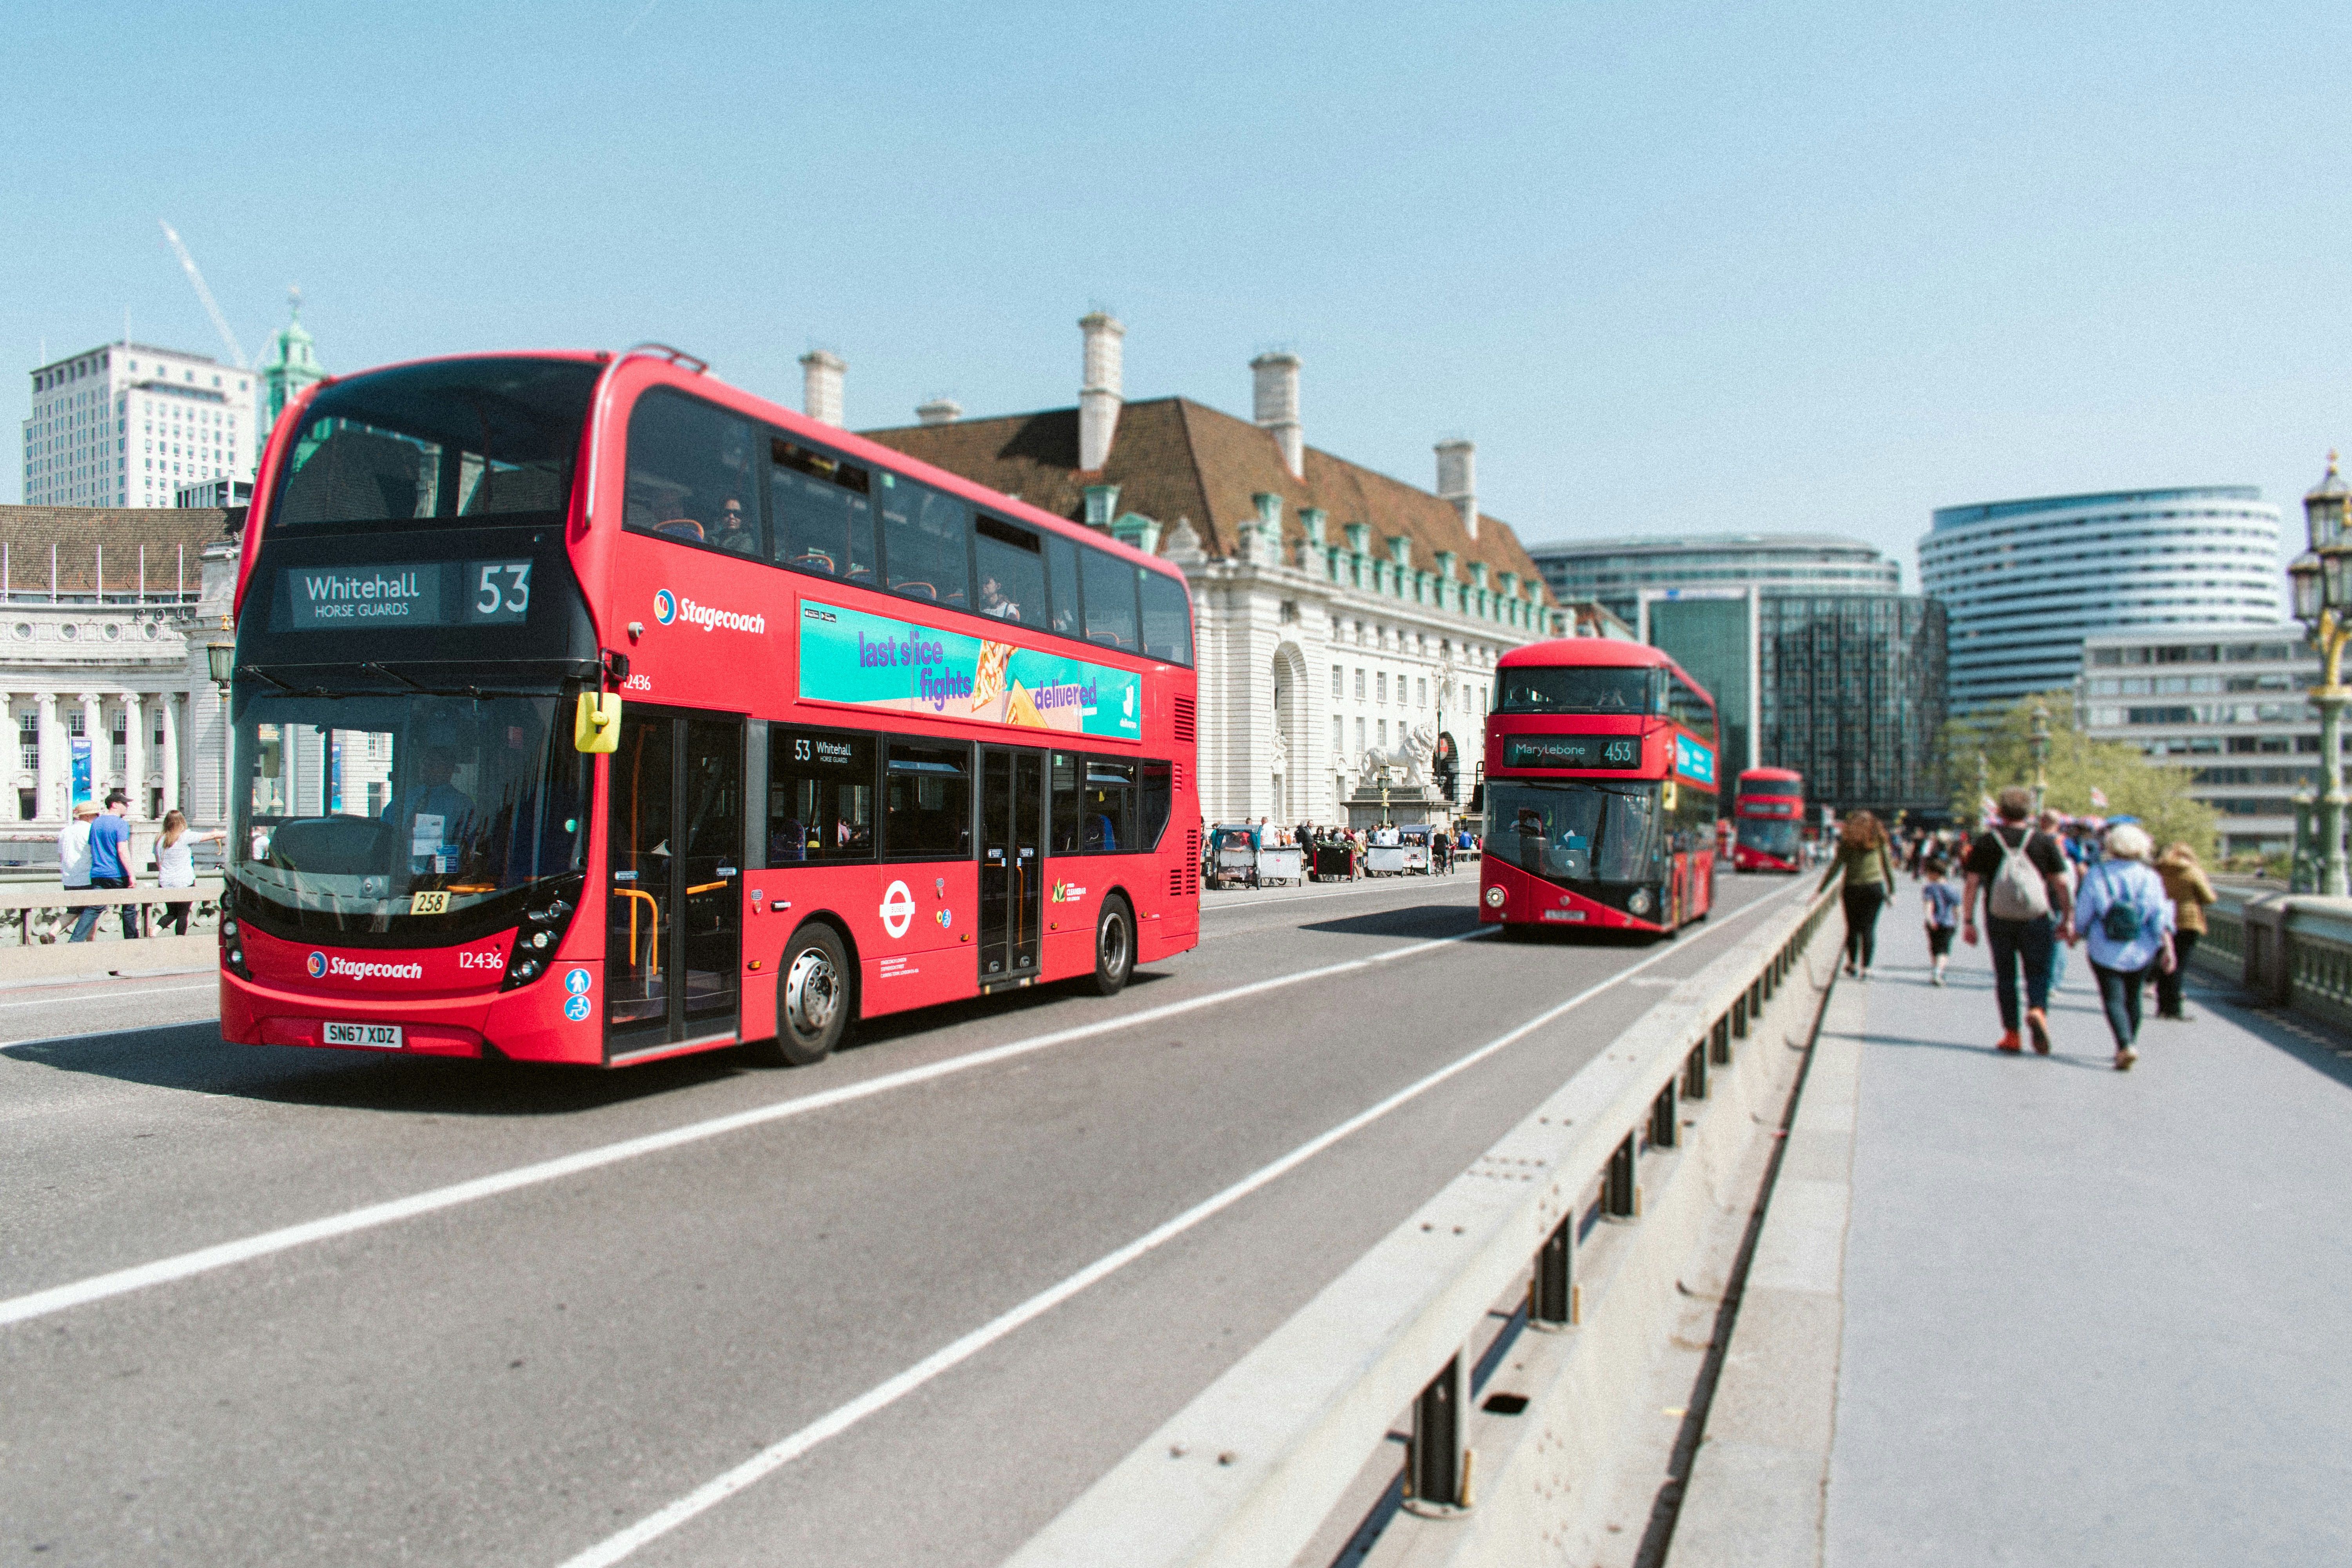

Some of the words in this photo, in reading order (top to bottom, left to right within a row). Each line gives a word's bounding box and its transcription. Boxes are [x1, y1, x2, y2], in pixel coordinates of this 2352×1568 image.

[306, 572, 421, 600] Whitehall
[477, 564, 532, 614] 53
[315, 604, 354, 618] HORSE
[358, 602, 409, 616] GUARDS
[679, 598, 765, 634] Stagecoach
[858, 631, 897, 667] last
[900, 630, 944, 666] slice
[920, 667, 972, 711] fights
[1035, 677, 1097, 710] delivered
[795, 739, 811, 760] 53
[816, 741, 852, 756] Whitehall
[1515, 744, 1586, 757] Marylebone
[1604, 742, 1631, 761] 453
[416, 894, 444, 912] 258
[330, 957, 423, 980] Stagecoach
[459, 952, 504, 969] 12436
[330, 1025, 364, 1042] SN67
[368, 1027, 395, 1044] XDZ
